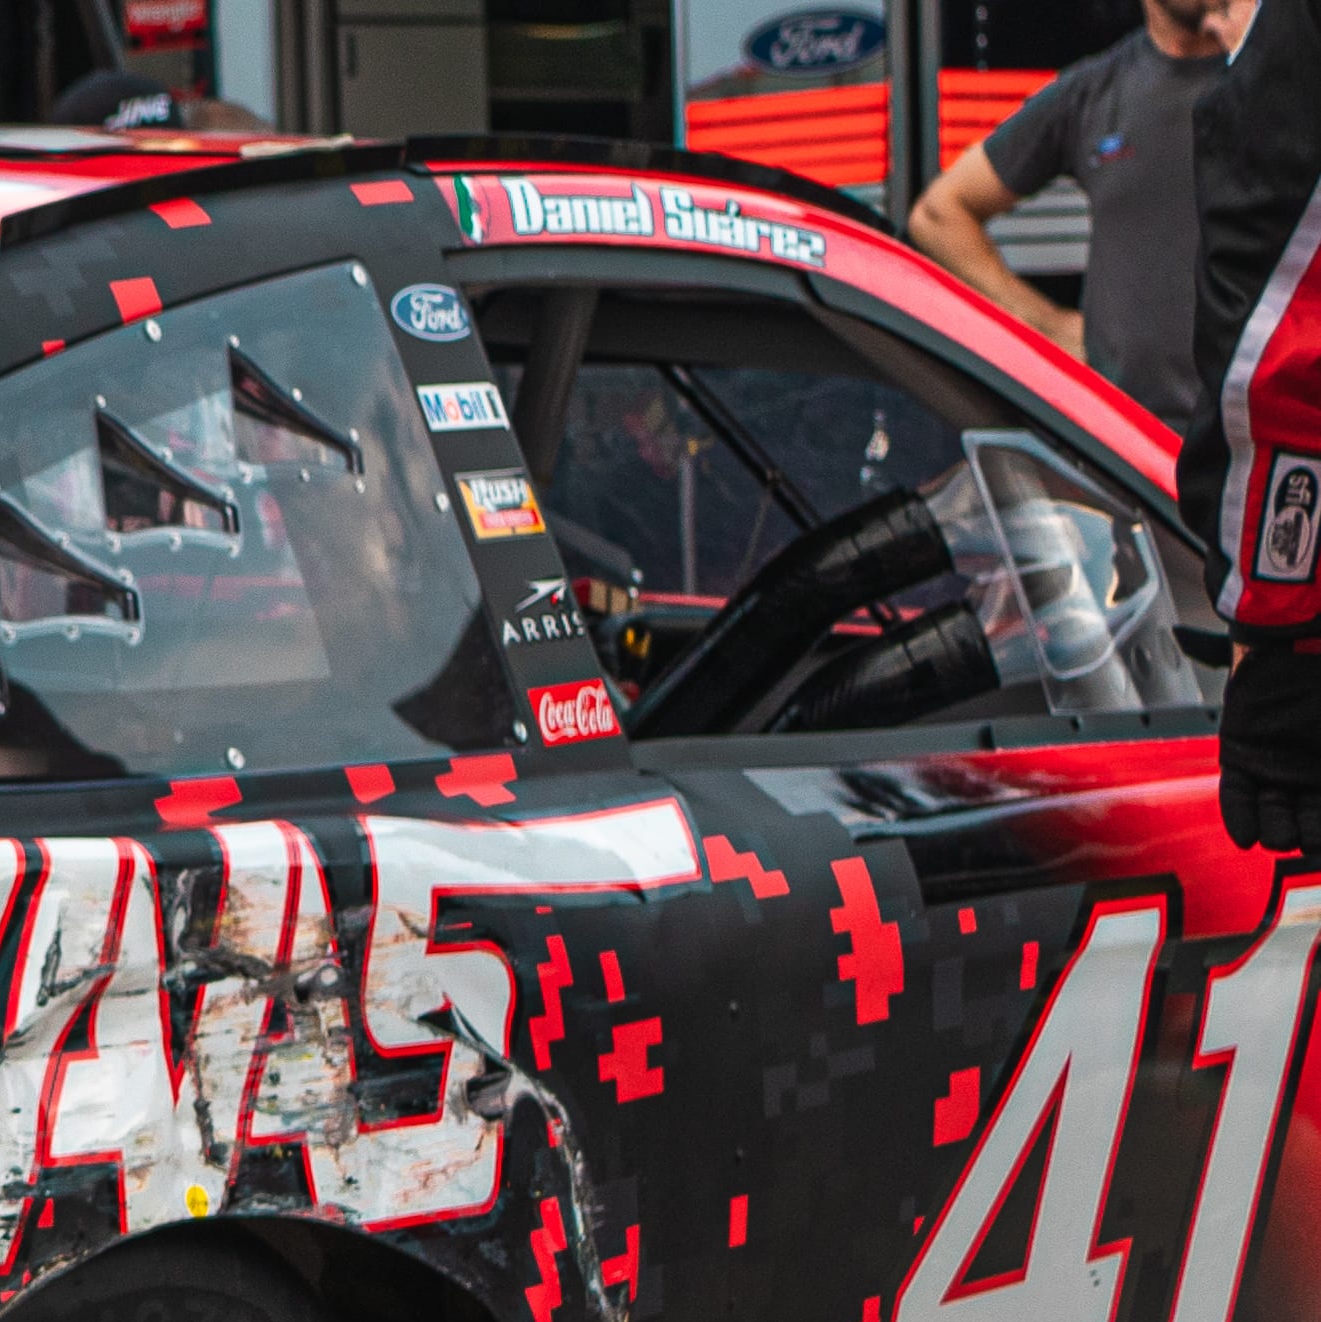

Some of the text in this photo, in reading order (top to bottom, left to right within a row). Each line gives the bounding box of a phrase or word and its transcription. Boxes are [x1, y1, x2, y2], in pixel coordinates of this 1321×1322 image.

[770, 18, 866, 68] Ford
[499, 175, 655, 237] Daniel
[410, 290, 463, 331] Ford
[423, 390, 488, 423] Mobil
